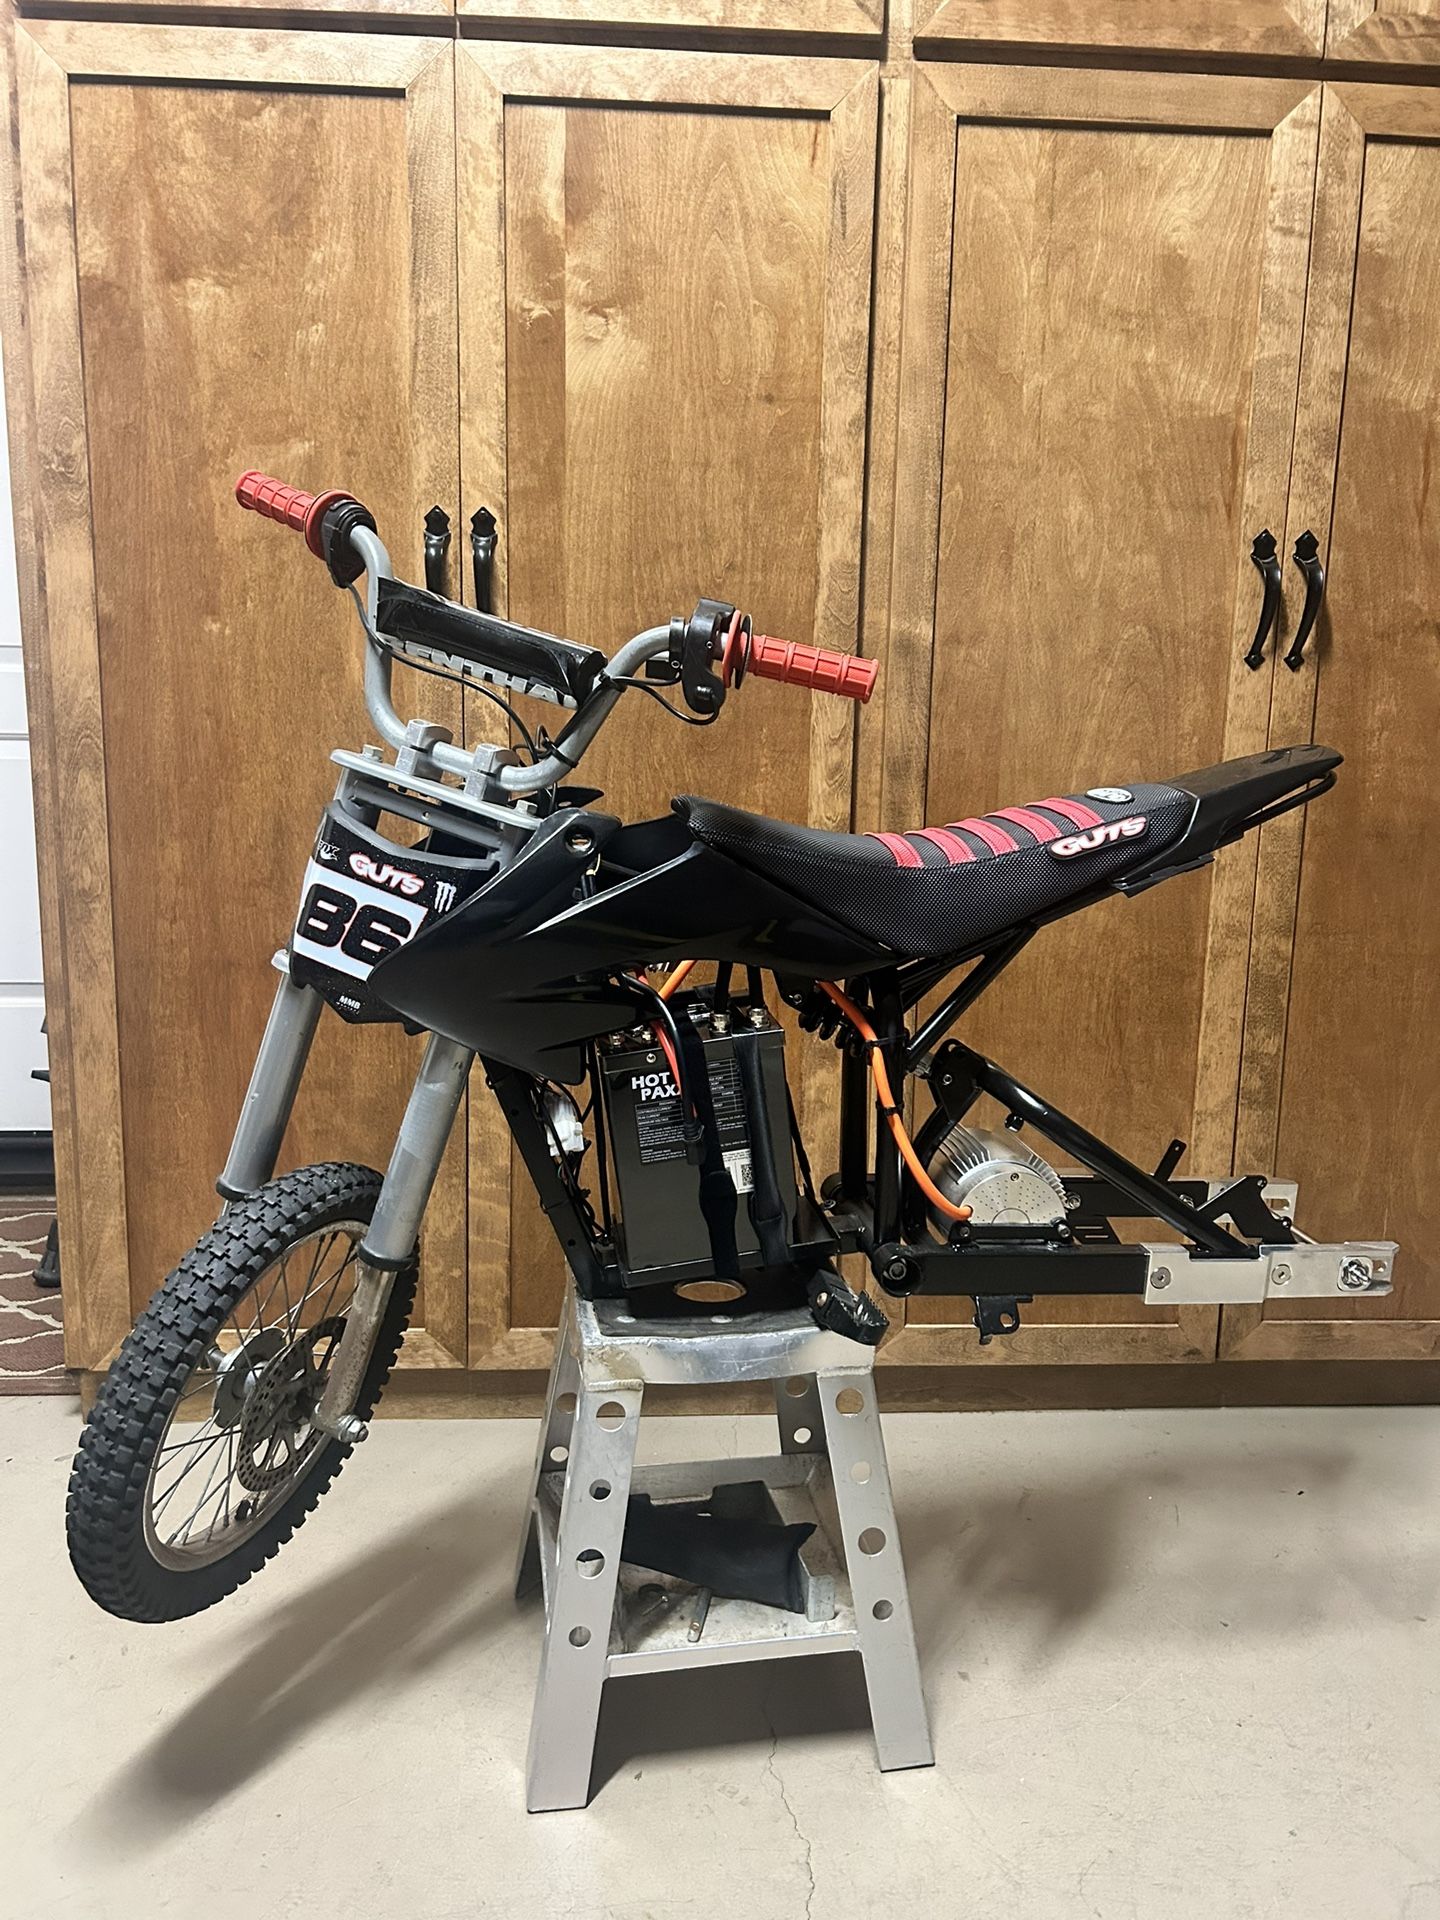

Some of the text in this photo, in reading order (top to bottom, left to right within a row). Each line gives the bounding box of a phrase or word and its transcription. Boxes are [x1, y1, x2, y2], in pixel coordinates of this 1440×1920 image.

[1051, 816, 1147, 856] GUTS
[349, 852, 424, 896] GUTS
[297, 883, 412, 967] 86
[338, 995, 361, 1010] MMB
[631, 1071, 670, 1090] HOT
[641, 1084, 682, 1102] PAX
